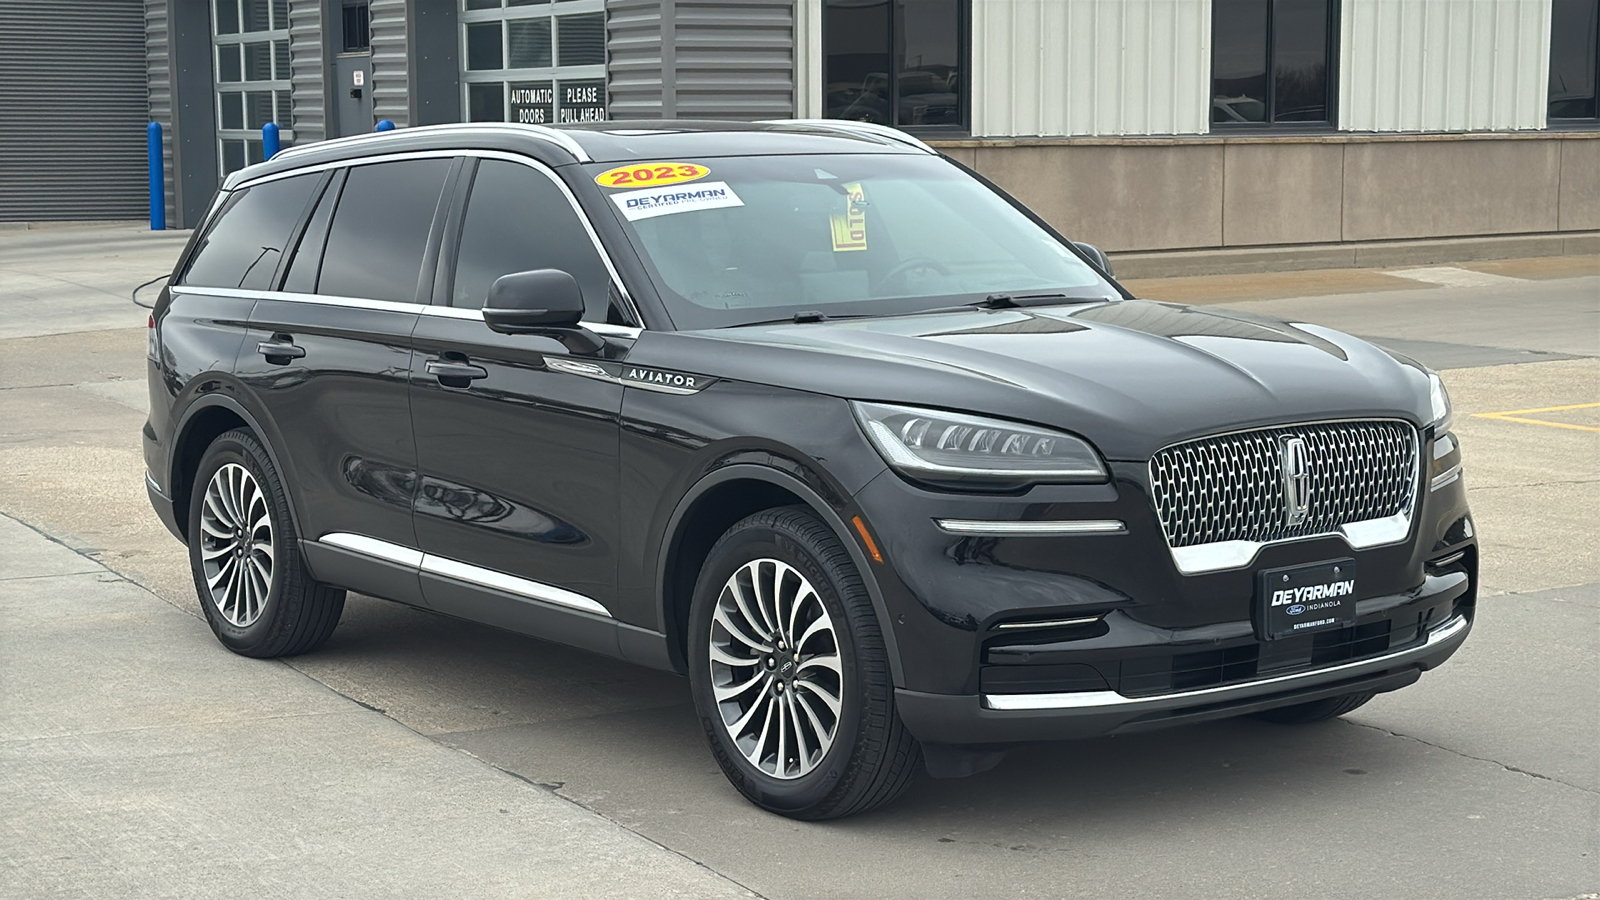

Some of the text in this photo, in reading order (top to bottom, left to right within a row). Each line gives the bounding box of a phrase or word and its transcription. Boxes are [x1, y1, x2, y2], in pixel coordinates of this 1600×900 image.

[511, 89, 552, 104] AUTOMATIC
[567, 87, 597, 103] PLEASE
[519, 108, 545, 123] DOORS
[560, 107, 605, 123] PULL AHEAD
[610, 165, 700, 186] 2023
[626, 189, 726, 208] DEYARMAN
[637, 200, 679, 211] CERTIFIED
[629, 368, 696, 387] AVIATOR
[1271, 580, 1355, 607] DEYARMAN
[1306, 600, 1342, 611] INDIANOLA
